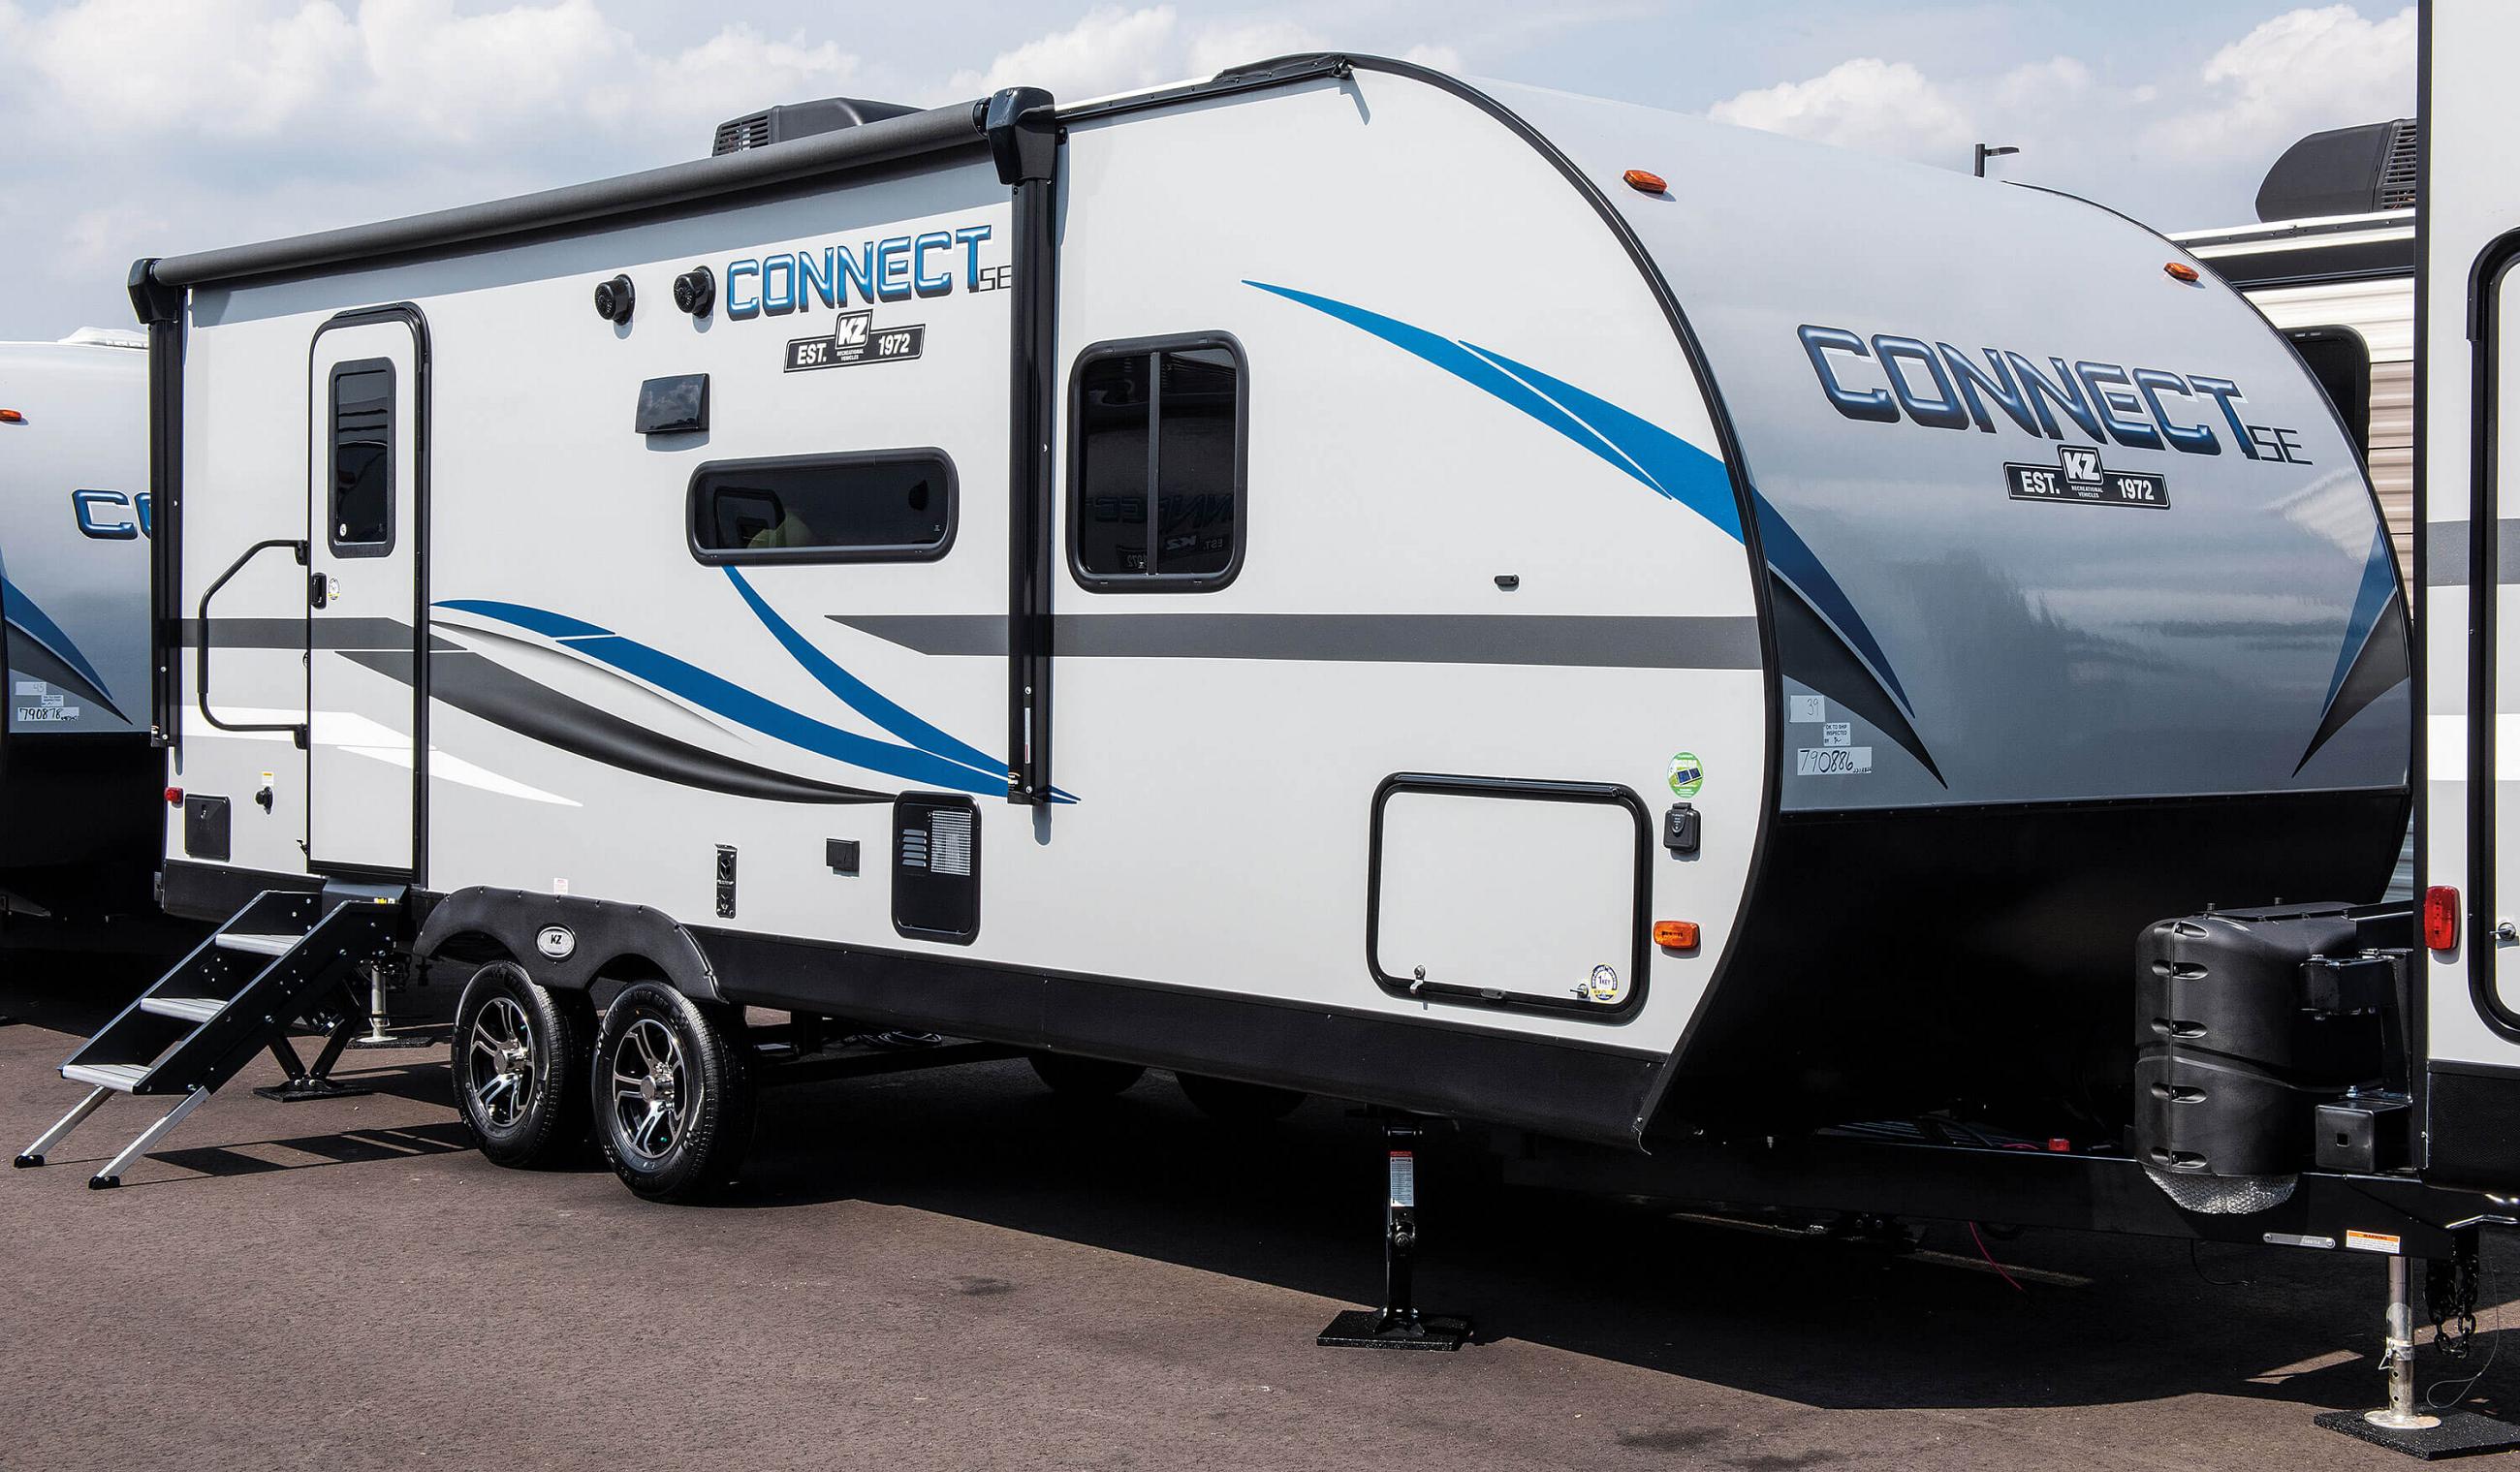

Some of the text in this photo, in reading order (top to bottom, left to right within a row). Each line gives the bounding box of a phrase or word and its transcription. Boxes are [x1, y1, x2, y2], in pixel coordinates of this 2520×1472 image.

[727, 225, 1012, 322] CONNECT SE
[838, 316, 869, 346] KZ
[797, 332, 911, 365] EST. 1972
[1797, 324, 2314, 465] CONNECT SE
[2063, 451, 2101, 482] KZ
[2020, 470, 2155, 501] EST. 1972
[2070, 485, 2104, 493] RECREATIONAL
[1800, 749, 1854, 773] 790886
[550, 934, 562, 945] KZ
